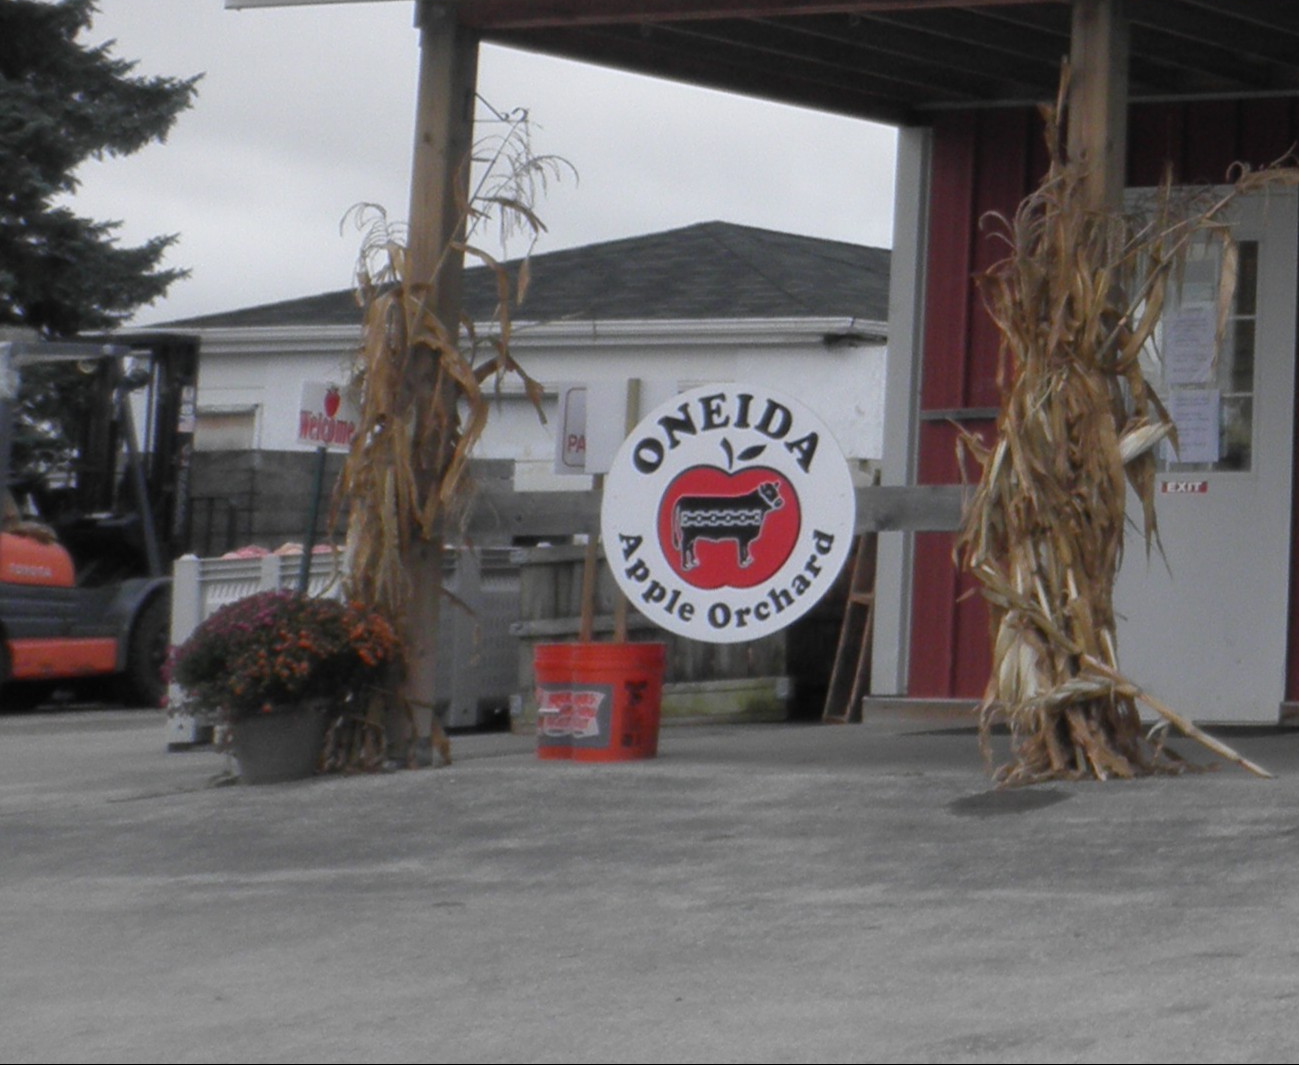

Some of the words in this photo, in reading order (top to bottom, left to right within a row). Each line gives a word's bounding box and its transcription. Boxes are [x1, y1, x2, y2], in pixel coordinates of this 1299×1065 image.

[632, 392, 820, 474] ONEIDA
[1167, 481, 1202, 493] EXIT
[618, 532, 696, 622] Apple
[707, 528, 835, 629] Orchard
